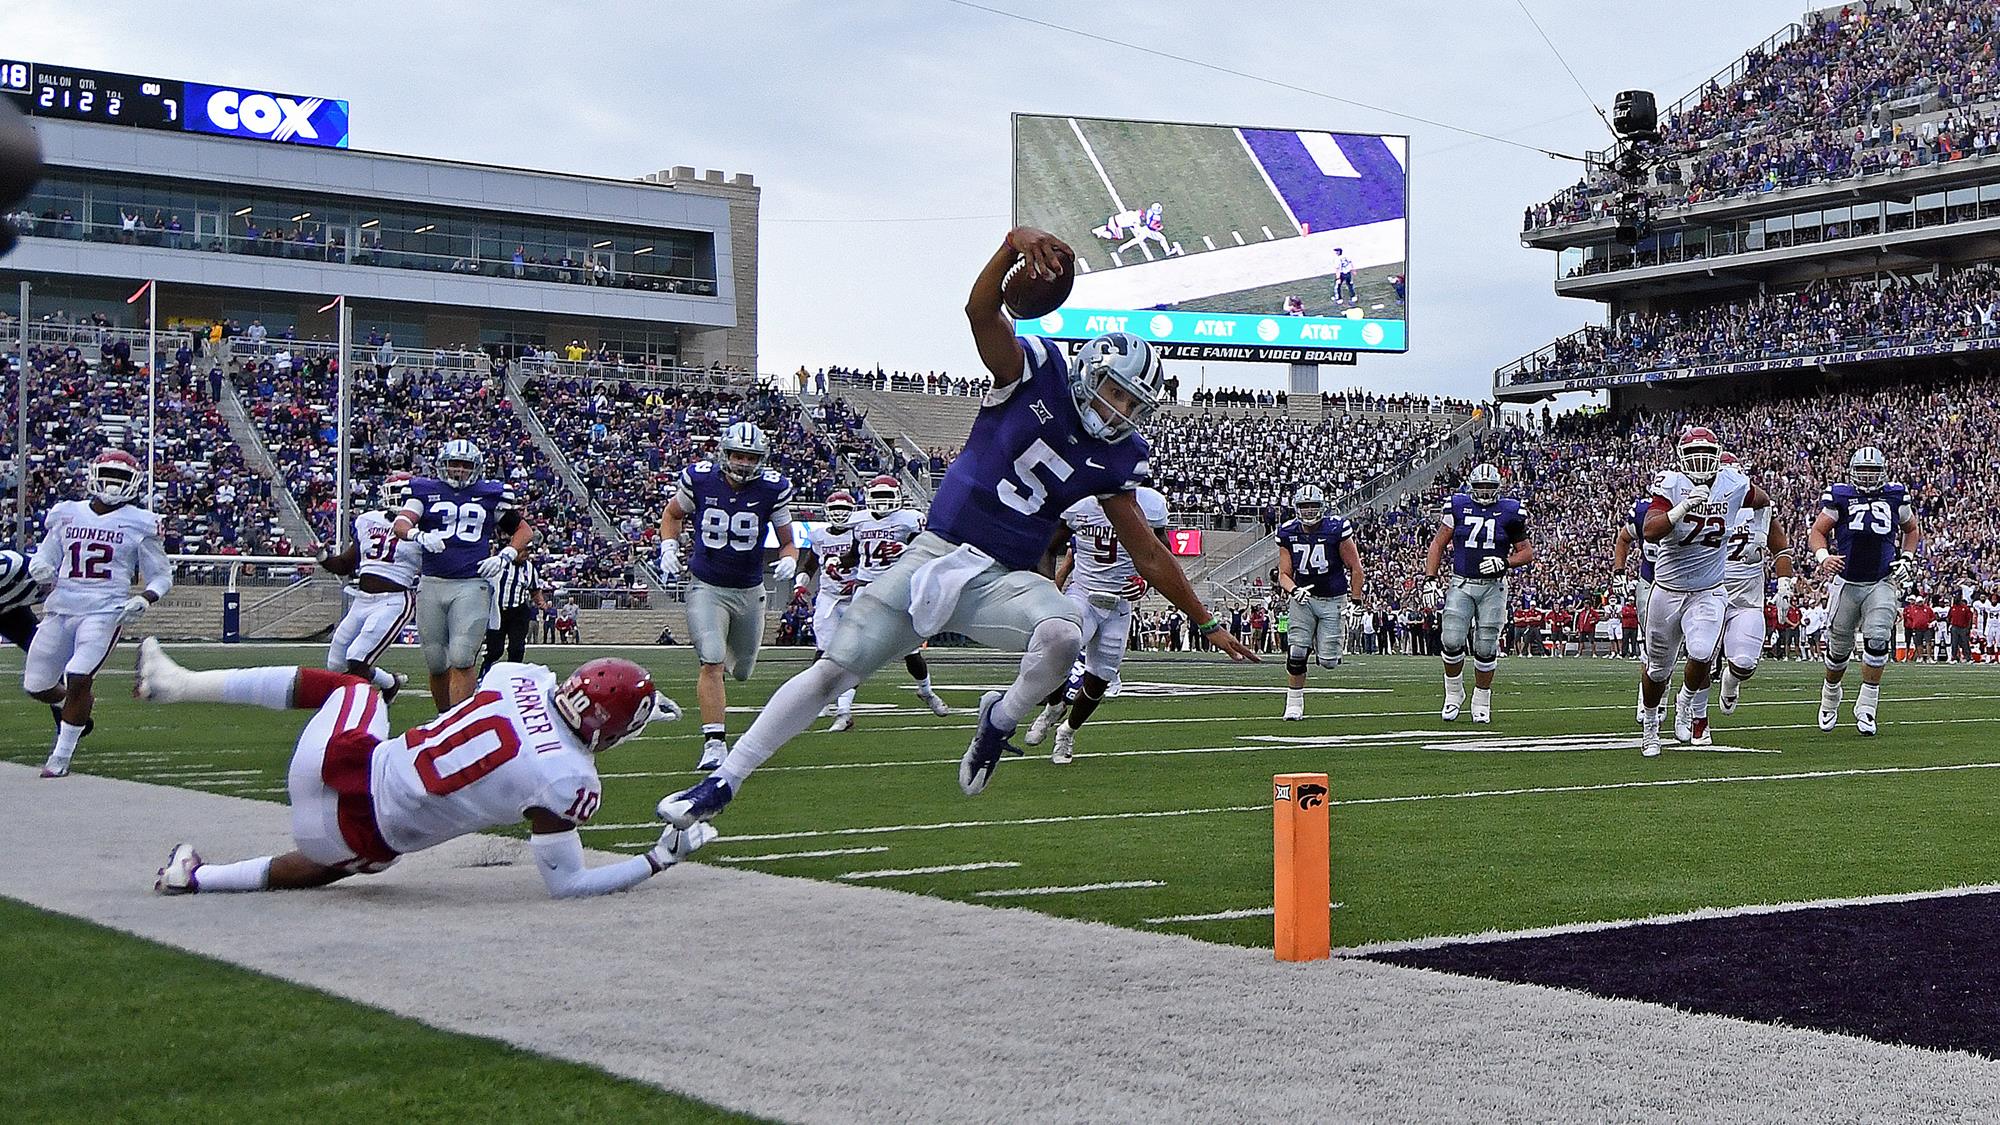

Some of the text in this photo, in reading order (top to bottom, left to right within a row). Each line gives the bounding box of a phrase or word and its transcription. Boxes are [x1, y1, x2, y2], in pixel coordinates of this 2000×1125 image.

[38, 74, 72, 87] BALL ON
[142, 83, 161, 96] OU
[108, 99, 121, 115] 2
[163, 99, 178, 121] 7
[207, 91, 325, 141] COX
[1085, 316, 1128, 332] AT&T
[1194, 320, 1236, 336] AT&T
[1300, 323, 1341, 340] AT&T
[1177, 346, 1200, 357] ICE
[1203, 347, 1254, 358] FAMILY
[1259, 349, 1301, 360] VIDEO
[1305, 351, 1353, 362] BOARD
[1829, 352, 1857, 364] MARK
[1860, 346, 1911, 361] SIMONEAU
[1913, 341, 1954, 355] 1996-99
[1694, 364, 1729, 376] MICHAEL
[1733, 361, 1764, 372] BISHOP
[997, 438, 1075, 516] 5
[429, 501, 487, 543] 38
[1691, 502, 1728, 515] OONERS
[1848, 501, 1892, 535] 79
[65, 526, 125, 545] SOONERS
[701, 507, 759, 551] 89
[1464, 516, 1496, 549] 71
[1678, 513, 1726, 549] 72
[68, 541, 114, 579] 12
[366, 534, 399, 563] 31
[863, 540, 893, 568] 14
[1094, 532, 1117, 564] 9
[1178, 541, 1188, 553] 7
[1293, 543, 1329, 574] 74
[567, 689, 591, 713] 10
[511, 677, 562, 755] PARKER II
[405, 690, 522, 796] 10
[564, 787, 599, 821] 10
